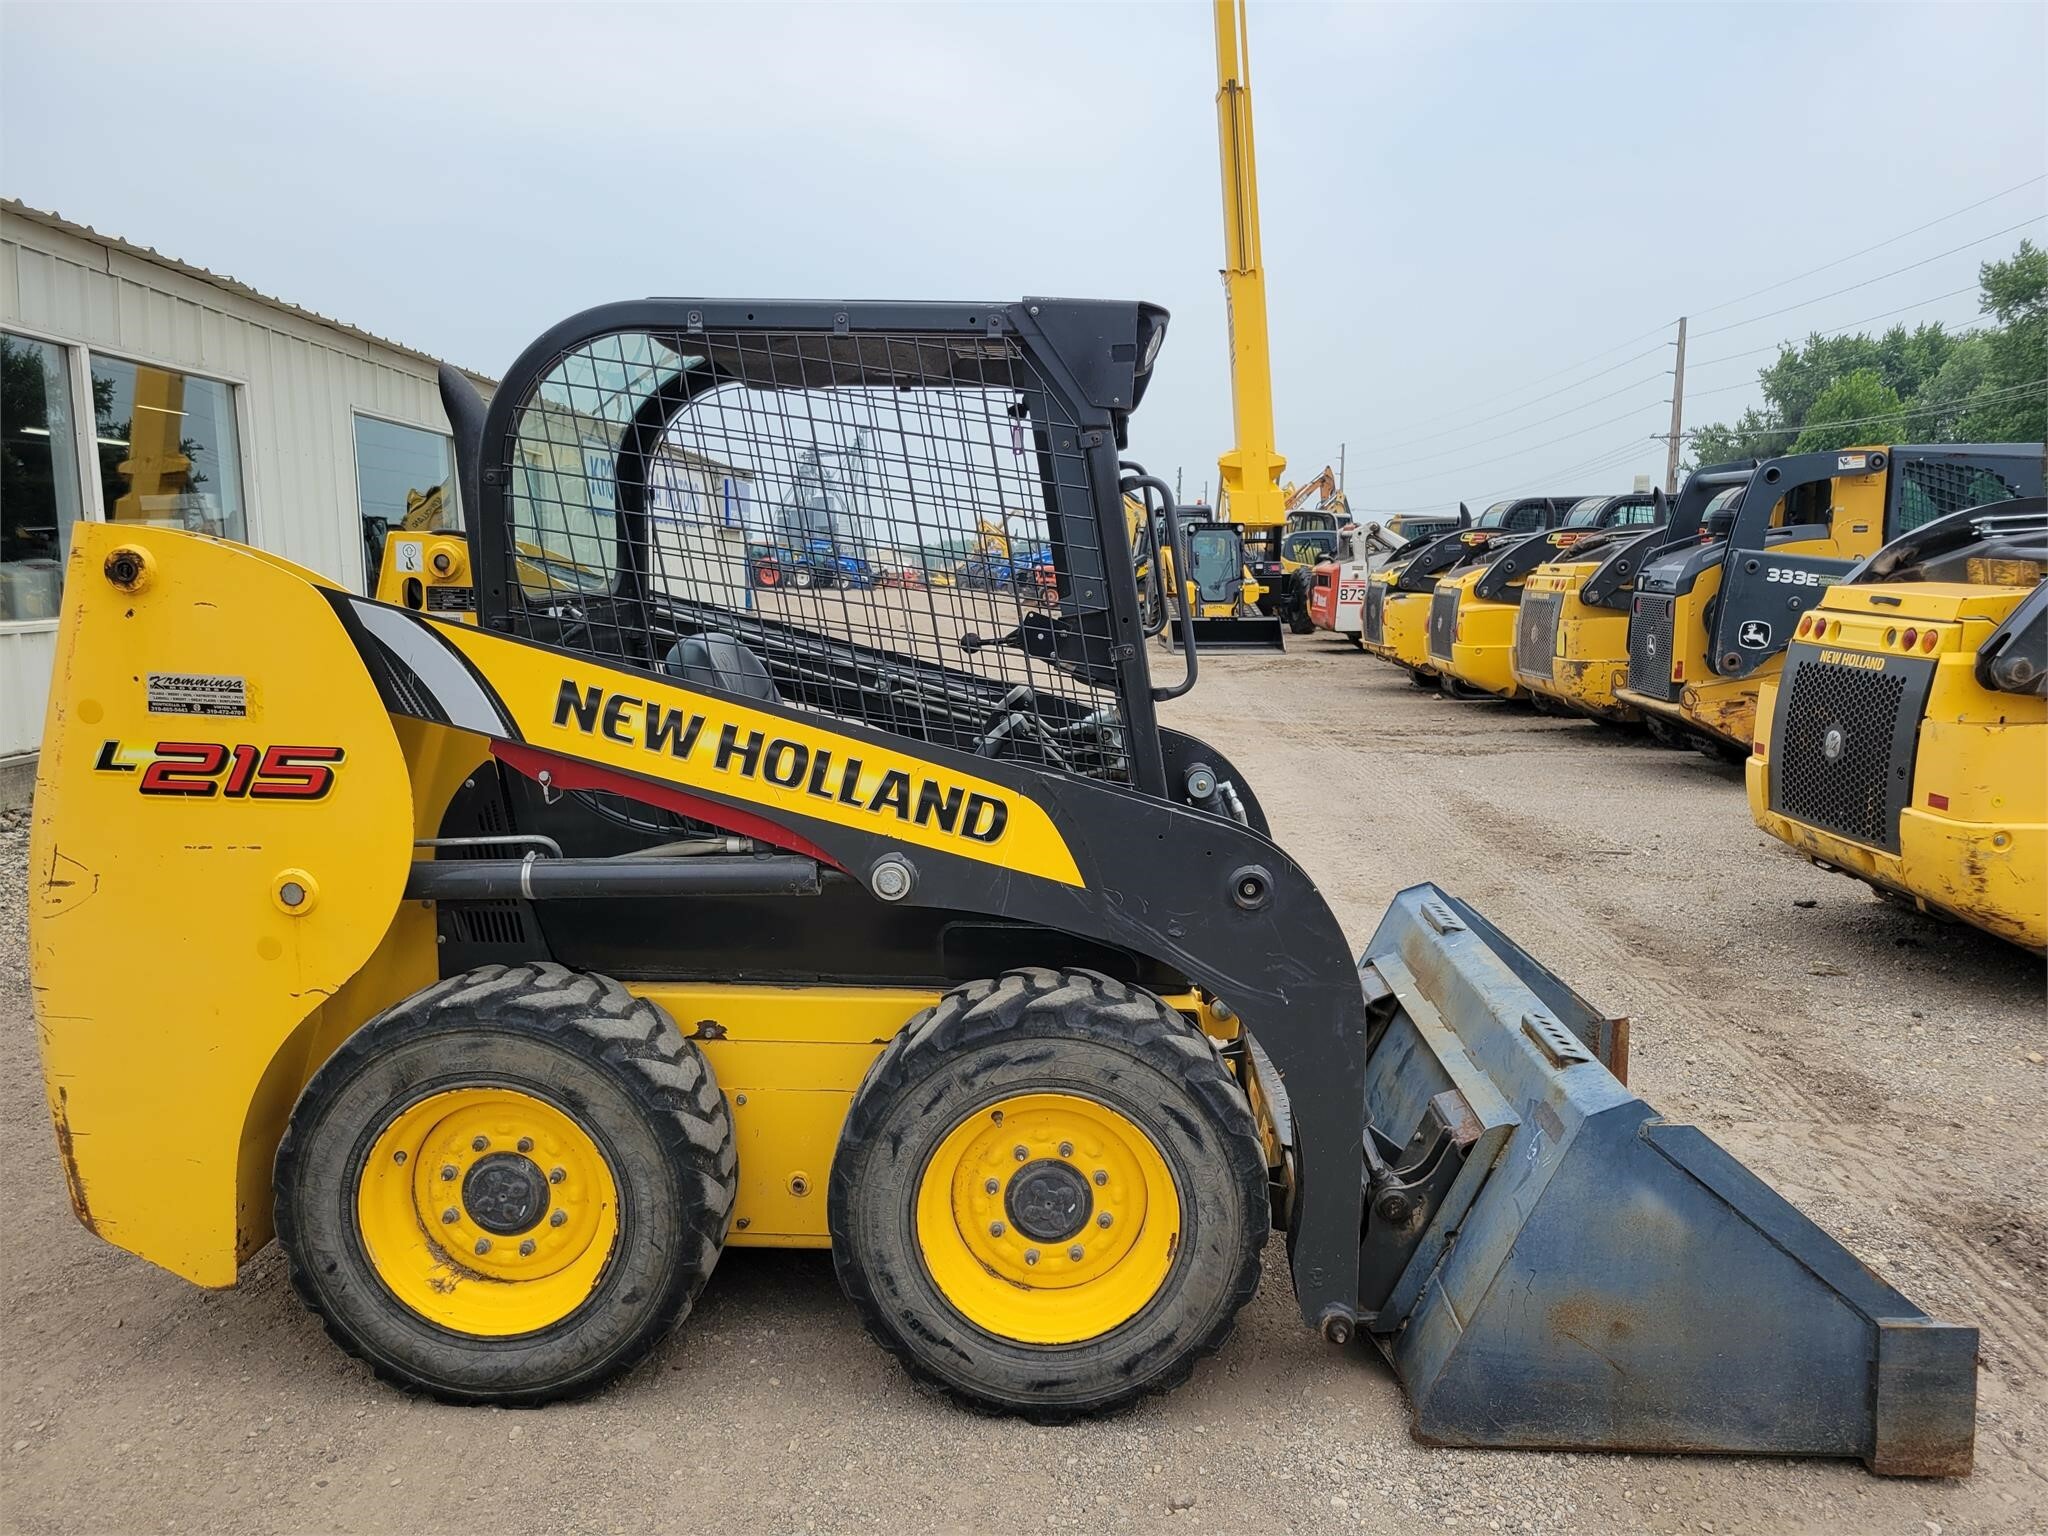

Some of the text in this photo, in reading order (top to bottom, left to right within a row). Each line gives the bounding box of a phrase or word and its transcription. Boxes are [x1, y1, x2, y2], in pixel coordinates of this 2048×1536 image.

[1766, 567, 1820, 587] 333E
[1340, 588, 1366, 601] 873
[1820, 649, 1886, 672] NEW HOLLAND
[149, 675, 244, 693] Kromminga
[552, 677, 1010, 845] NEW HOLLAND
